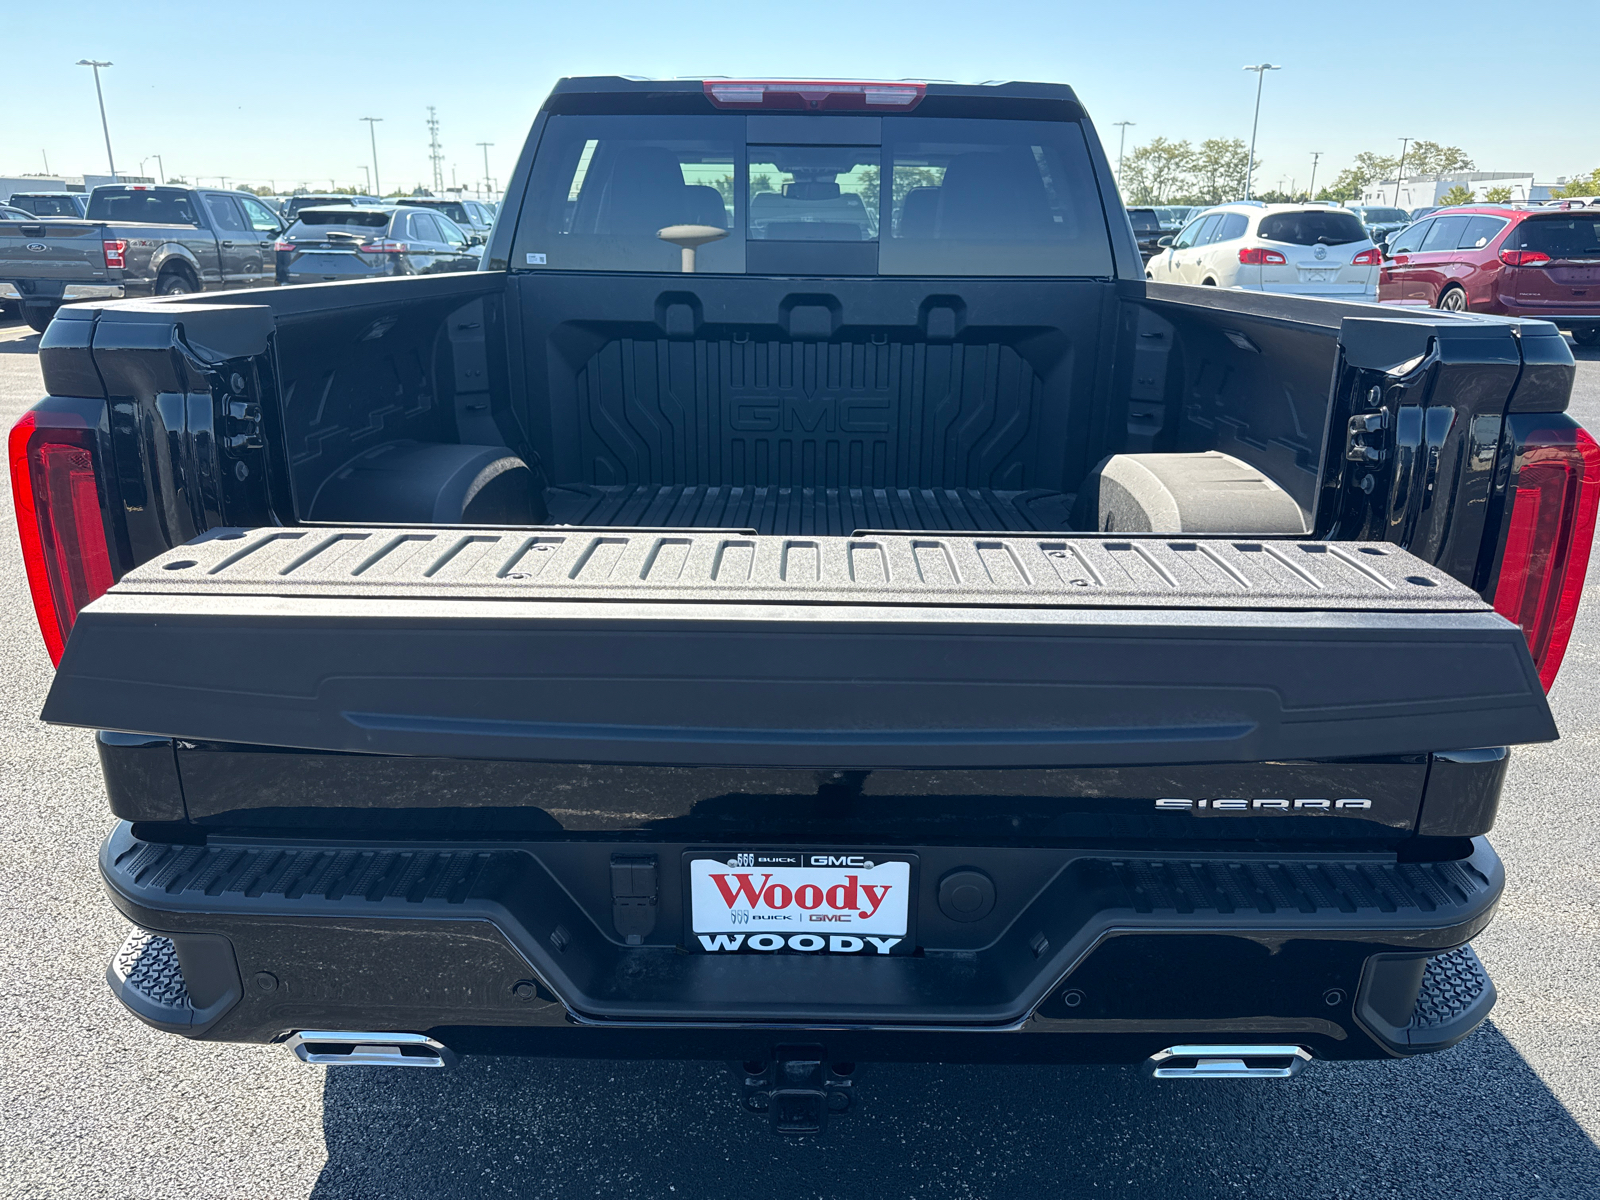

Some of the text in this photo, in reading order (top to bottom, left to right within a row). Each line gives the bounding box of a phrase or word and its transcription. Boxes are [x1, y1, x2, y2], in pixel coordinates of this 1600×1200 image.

[729, 395, 891, 434] GMC
[1154, 798, 1372, 811] SIERRA
[810, 855, 864, 866] GMC
[708, 873, 892, 920] Woody
[808, 914, 852, 923] GMC
[697, 934, 902, 954] WOODY
